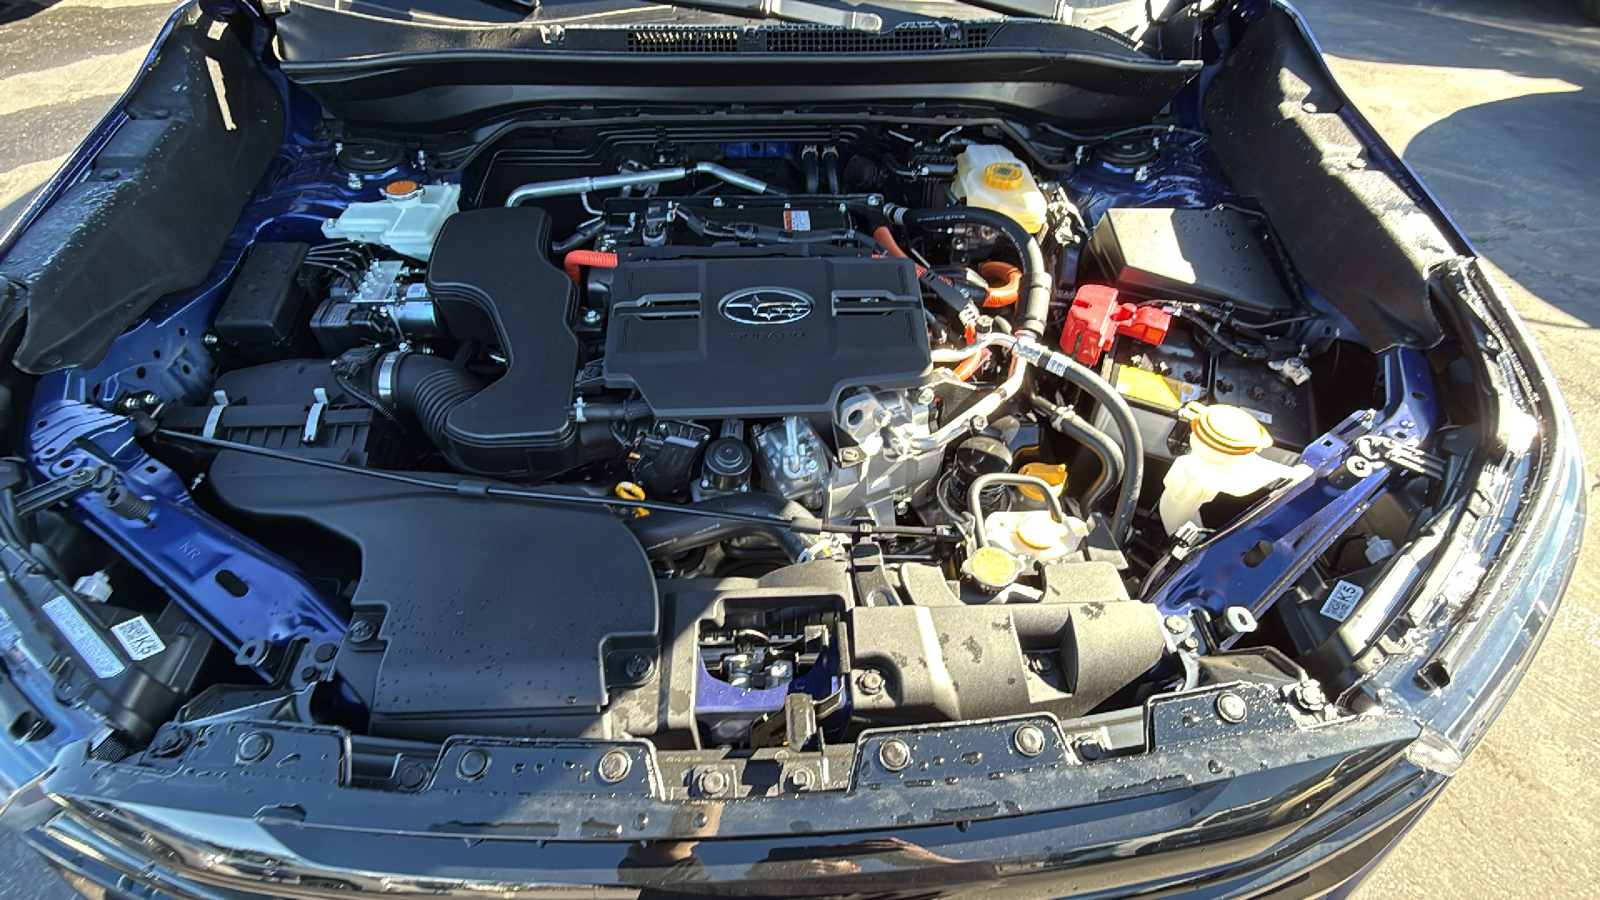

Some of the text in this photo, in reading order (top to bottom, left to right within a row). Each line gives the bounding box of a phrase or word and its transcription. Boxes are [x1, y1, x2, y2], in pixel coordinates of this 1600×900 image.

[730, 330, 806, 340] SUBARU
[179, 541, 201, 560] KR
[1338, 585, 1356, 602] K5
[131, 634, 155, 655] K5
